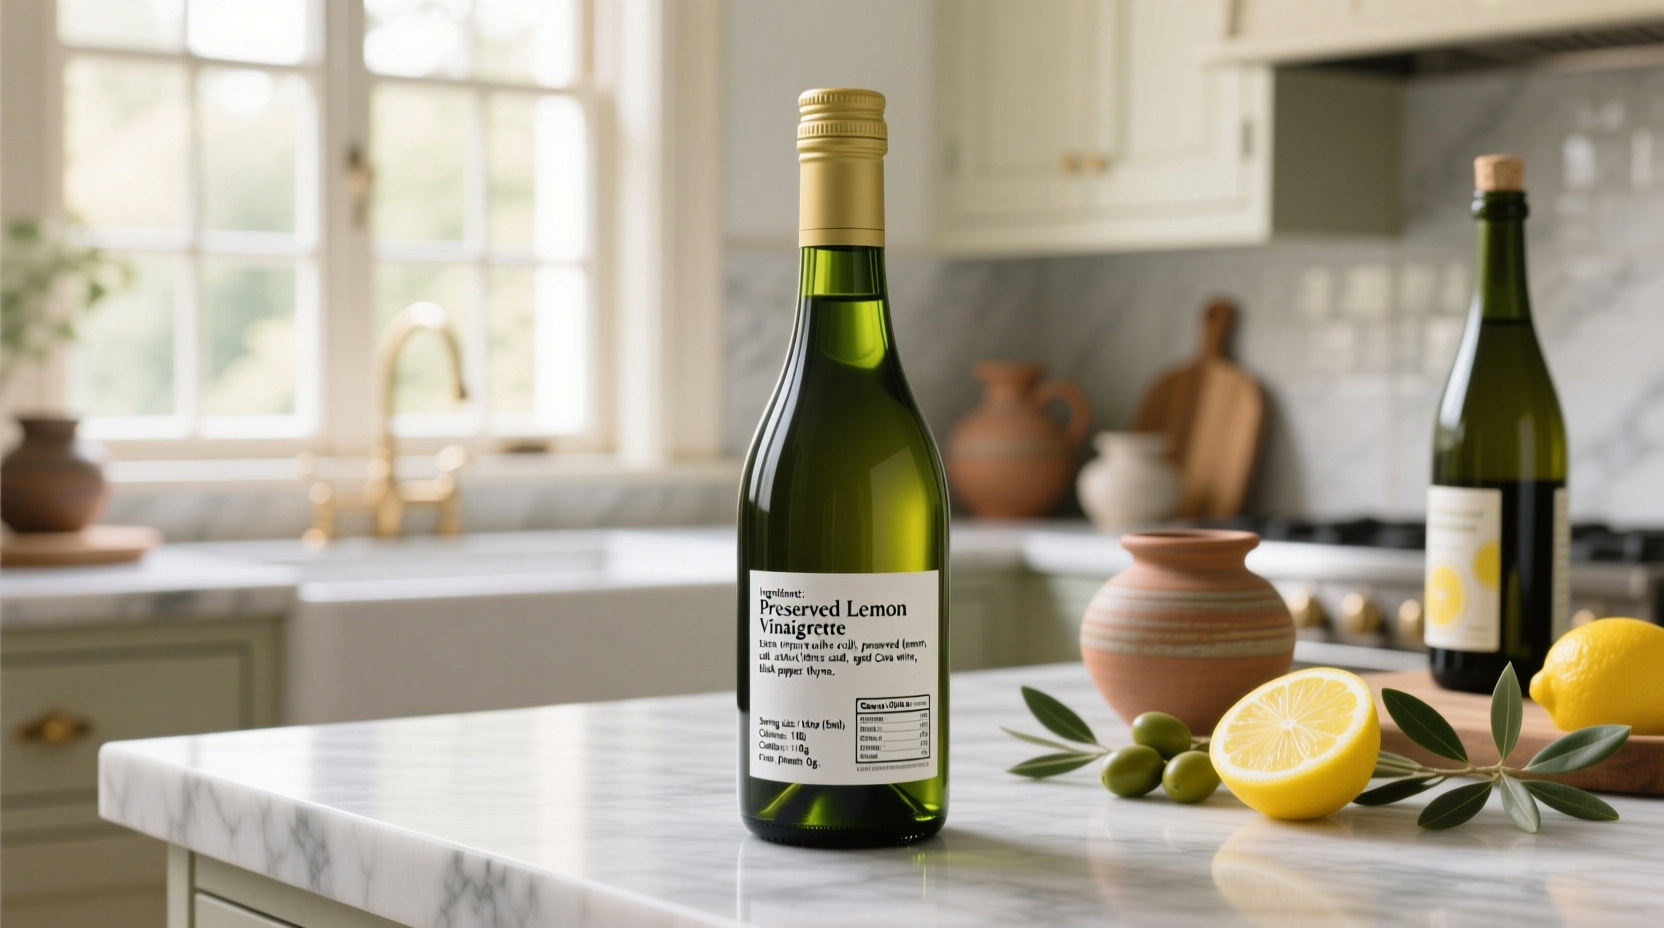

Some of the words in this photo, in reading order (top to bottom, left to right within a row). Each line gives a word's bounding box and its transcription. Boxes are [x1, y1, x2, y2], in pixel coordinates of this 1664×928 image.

[759, 599, 840, 617] Preserved
[846, 600, 907, 617] Lemon
[759, 617, 846, 640] Vinaigrette
